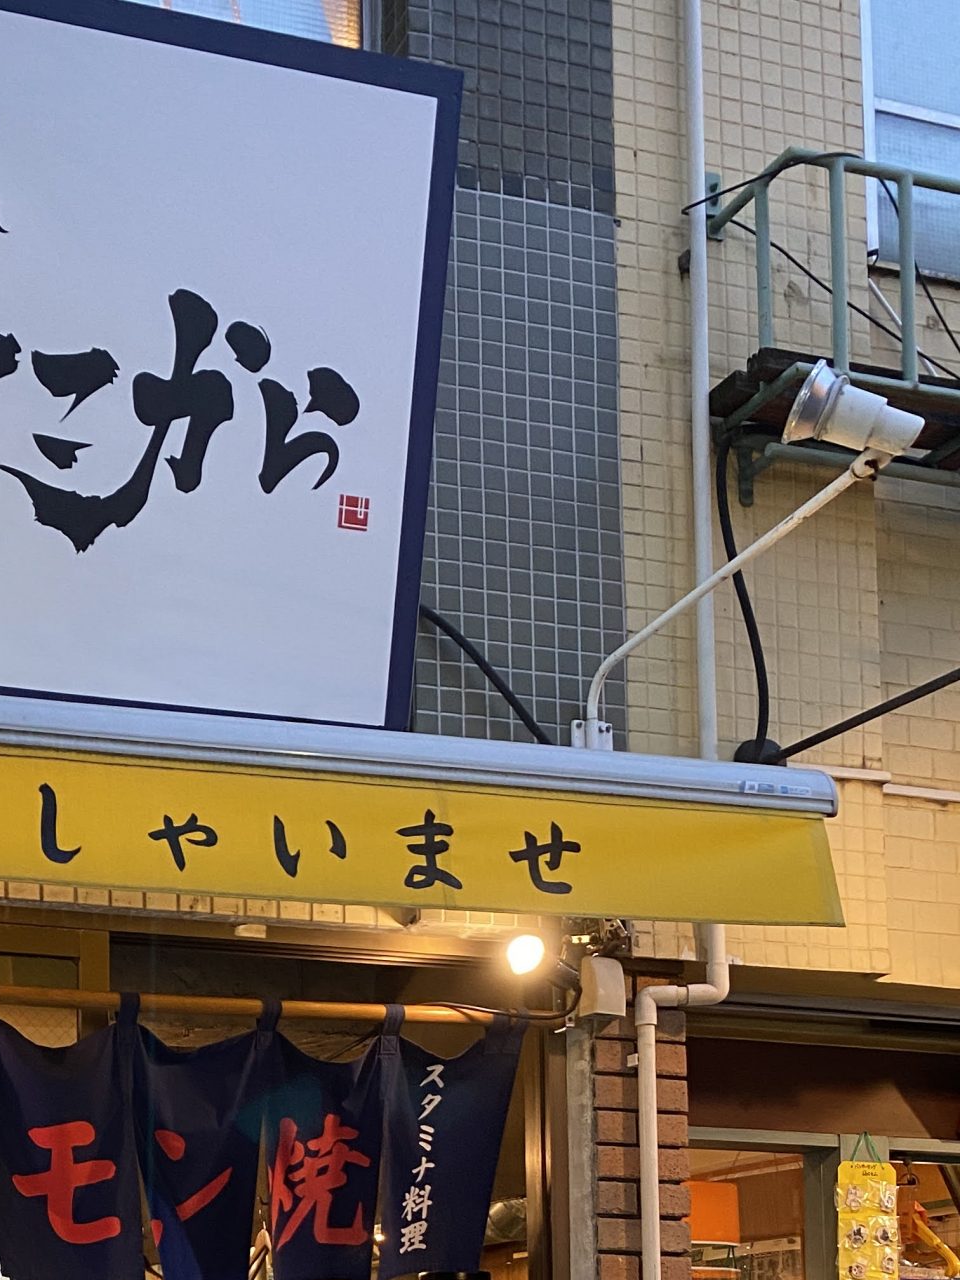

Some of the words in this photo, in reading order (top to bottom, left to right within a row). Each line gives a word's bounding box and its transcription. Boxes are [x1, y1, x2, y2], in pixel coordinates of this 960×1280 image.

[399, 1063, 446, 1257] スタミナ料理
